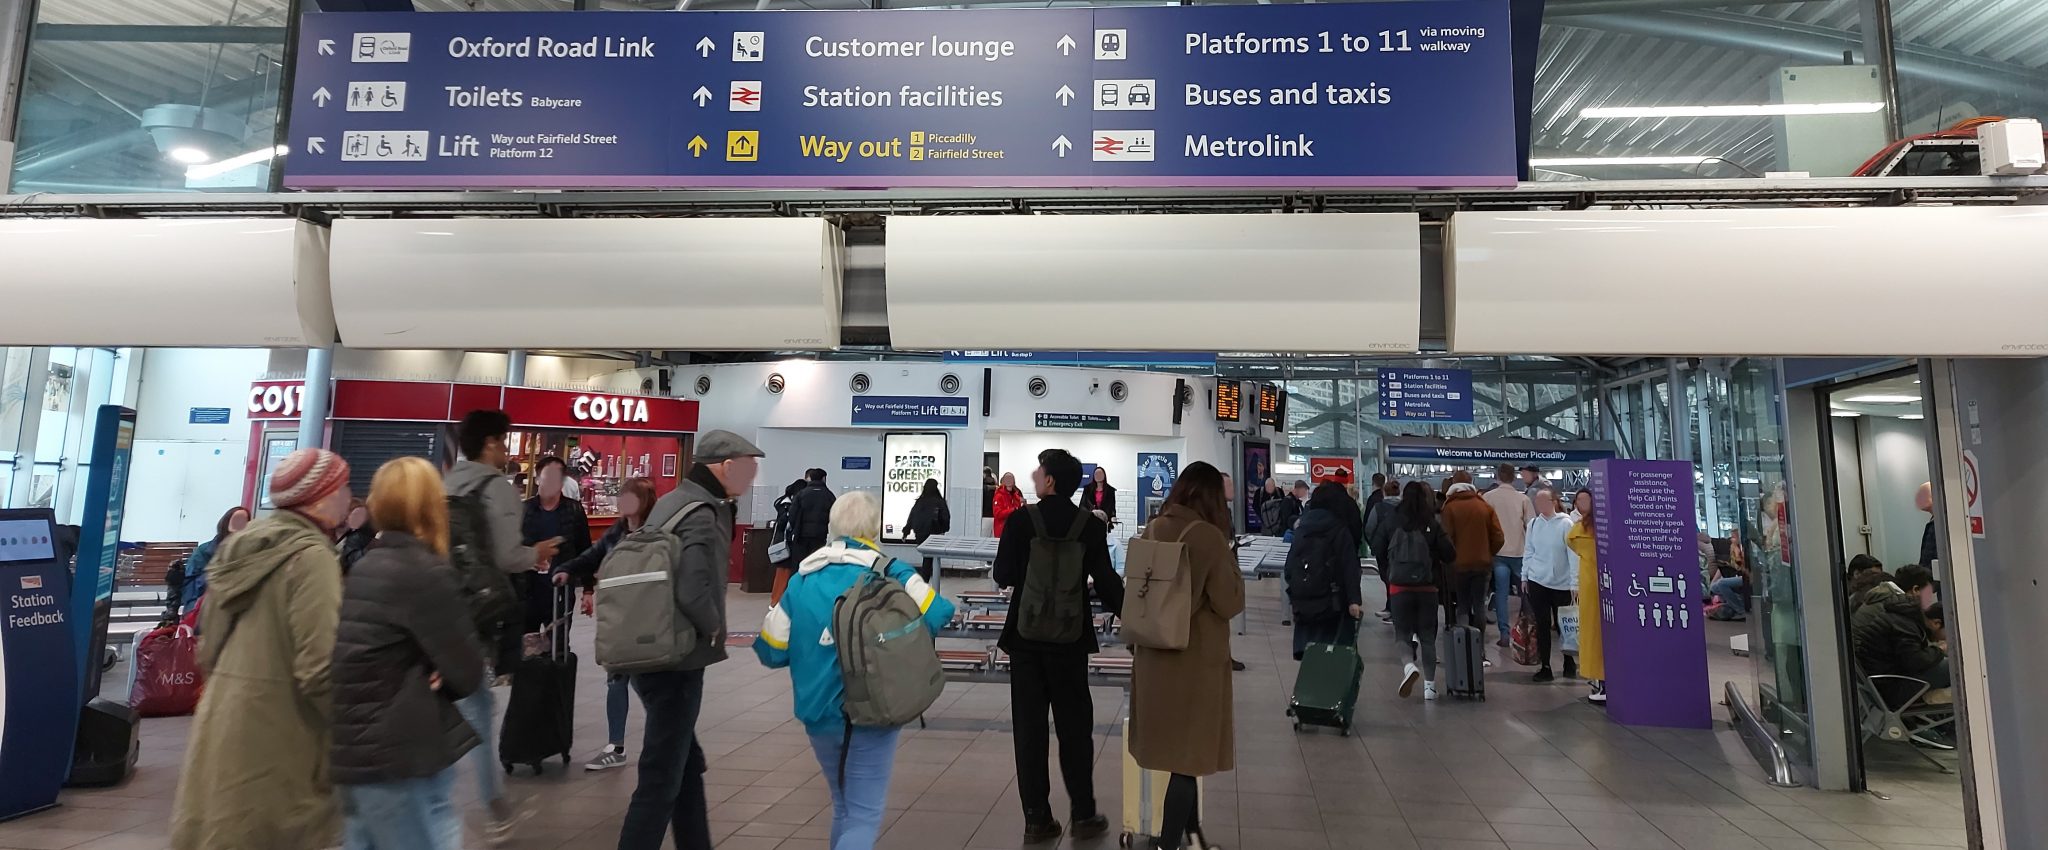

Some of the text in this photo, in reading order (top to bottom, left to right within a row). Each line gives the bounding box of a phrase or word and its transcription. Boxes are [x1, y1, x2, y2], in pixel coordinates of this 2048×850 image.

[1420, 26, 1485, 40] via moving
[448, 36, 655, 58] Oxford Road Link
[805, 35, 1015, 61] Customer lounge
[1185, 30, 1412, 54] Platforms 1 to 11
[1420, 40, 1471, 54] walkway
[445, 86, 581, 109] Toilets Babycare
[802, 84, 1003, 107] Station facilities
[1185, 82, 1391, 106] Buses and taxis
[438, 135, 480, 157] Lift
[491, 134, 617, 146] Way out Fairfield Street
[913, 133, 976, 146] 1 Piccadilly
[1184, 134, 1314, 157] Metrolink
[490, 148, 553, 158] Platform 12
[799, 135, 902, 162] Way out
[913, 149, 1004, 159] 2 Fairfield Street
[248, 386, 305, 415] COST
[573, 396, 648, 424] COSTA
[921, 405, 939, 415] Lift
[1436, 448, 1566, 460] Welcome to Manchester Piccadilly
[1640, 472, 1673, 480] passenger
[1624, 518, 1685, 528] alternatively speak
[1652, 543, 1673, 551] happy
[11, 593, 54, 608] Station
[9, 609, 64, 629] Feedback
[162, 671, 194, 686] M&S
